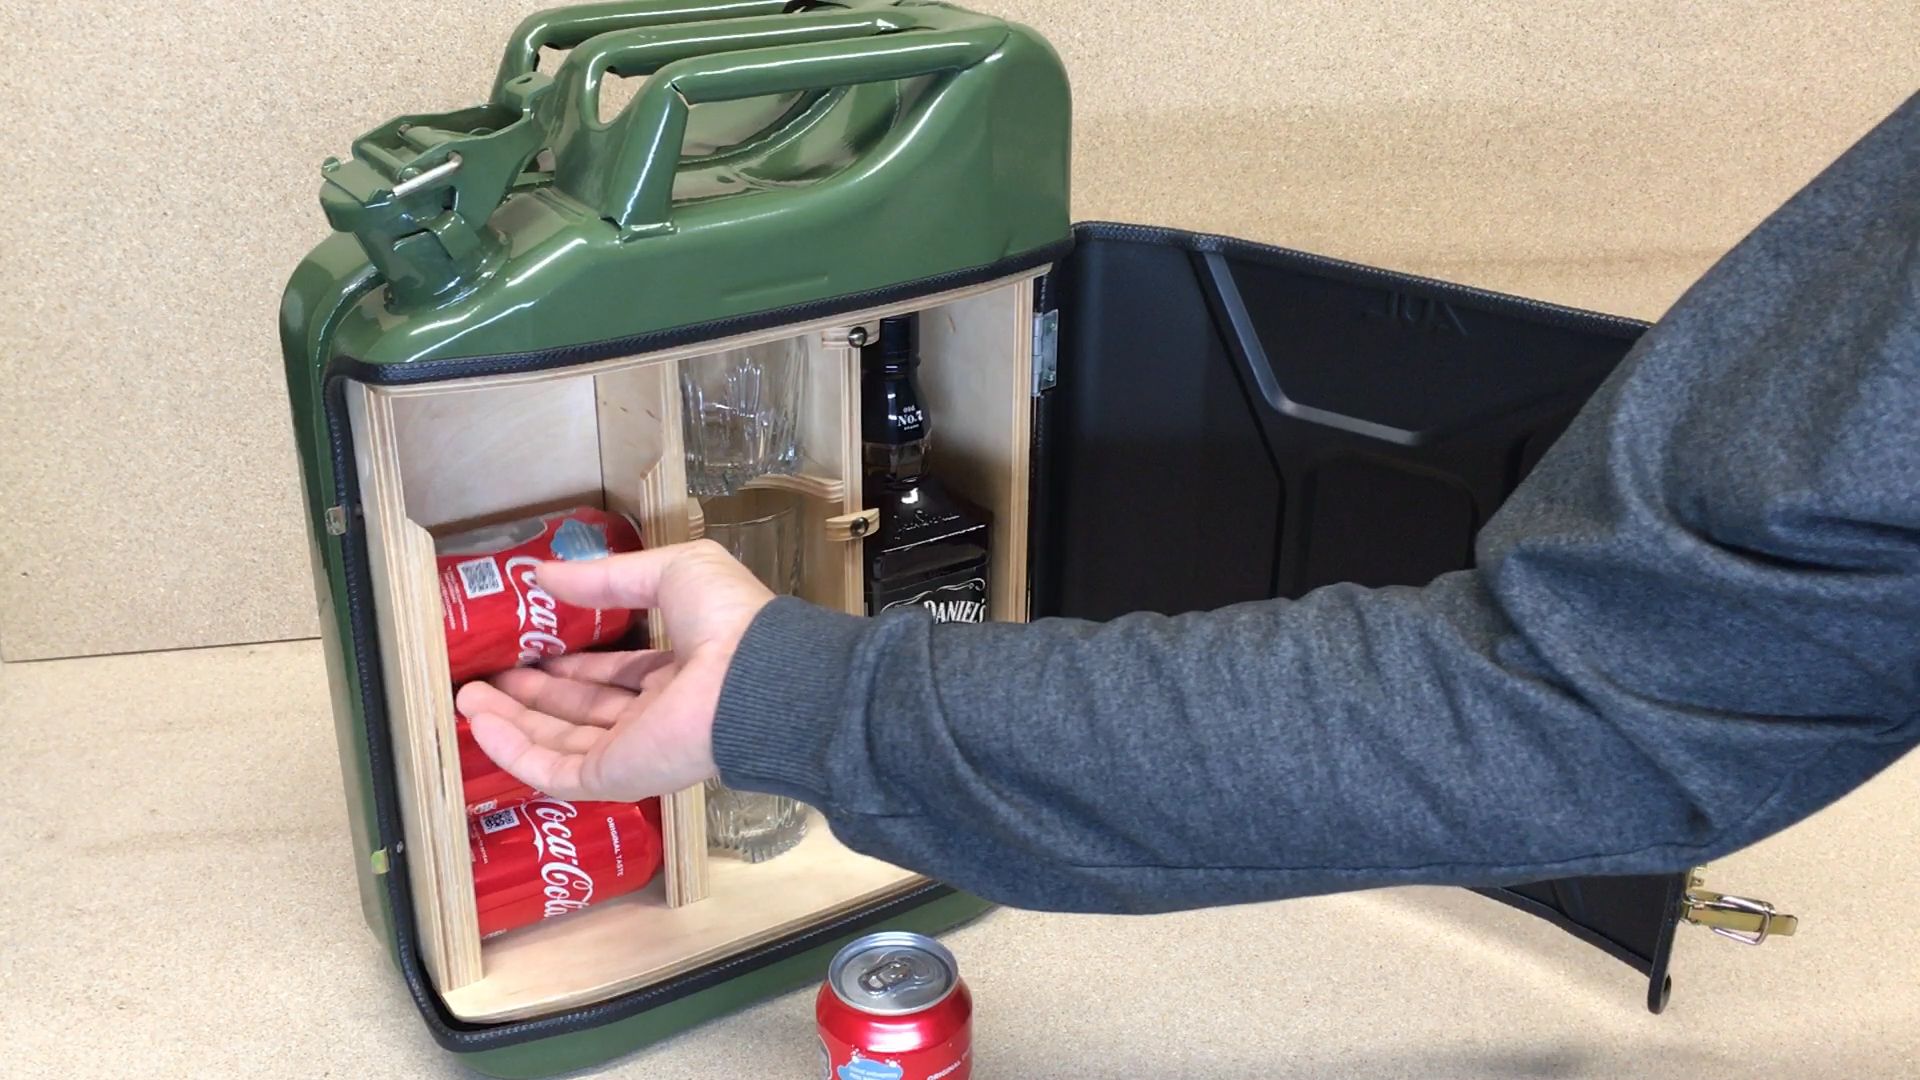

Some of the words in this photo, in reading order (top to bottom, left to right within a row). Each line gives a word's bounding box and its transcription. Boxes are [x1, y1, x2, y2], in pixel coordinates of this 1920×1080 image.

[520, 796, 594, 918] Coca-Cola
[606, 816, 621, 854] ORIGINAL
[616, 854, 625, 877] TASTE
